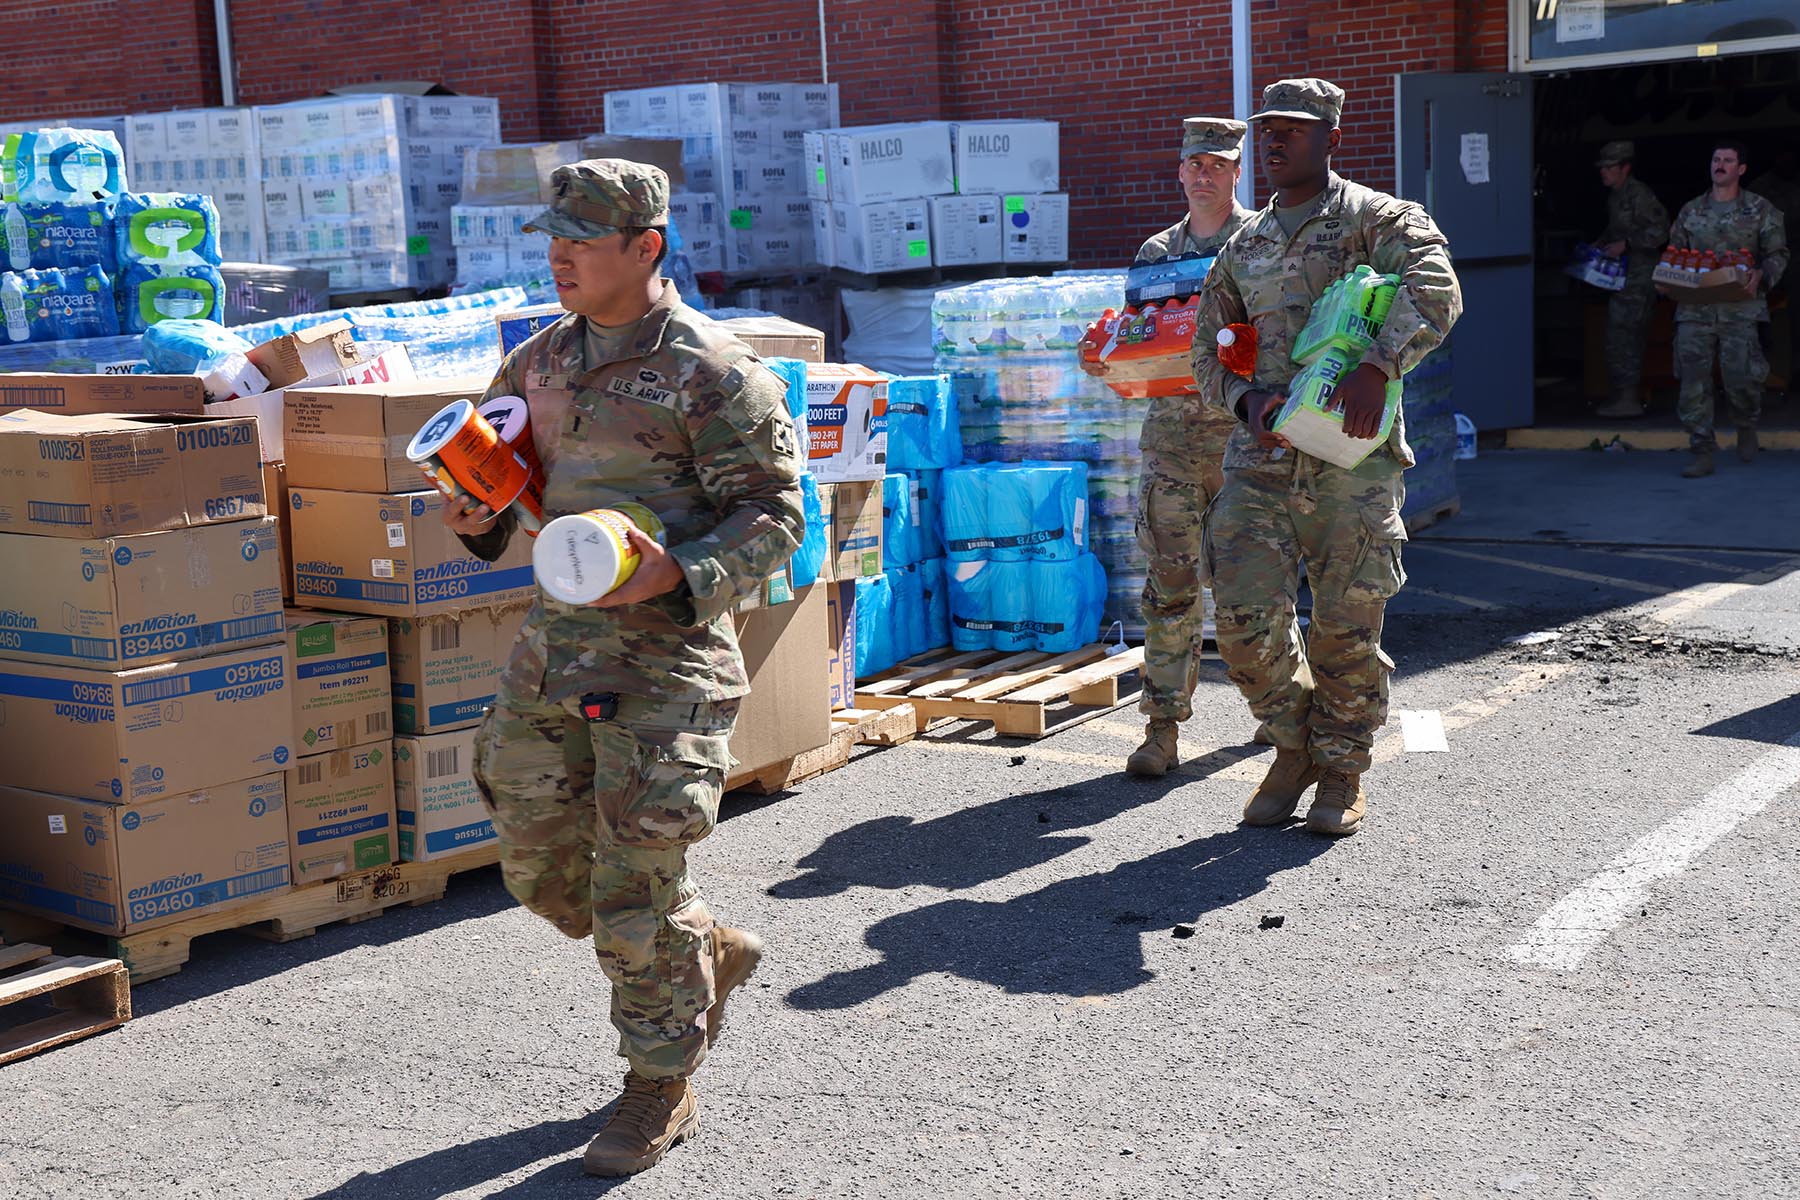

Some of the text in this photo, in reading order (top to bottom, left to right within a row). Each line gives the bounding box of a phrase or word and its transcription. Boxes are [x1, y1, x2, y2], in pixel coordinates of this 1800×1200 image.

[757, 92, 781, 101] SOFIA
[805, 92, 827, 101] SOFIA
[429, 106, 452, 116] SOFIA
[733, 130, 757, 139] SOFIA
[783, 130, 804, 139] SOFI
[860, 138, 903, 161] HALCO
[968, 134, 1010, 153] HALCO
[762, 168, 785, 177] SOFIA
[313, 189, 336, 199] SOFIA
[787, 203, 810, 213] SOFIA
[416, 220, 439, 230] SOFIA
[45, 226, 98, 240] niagara
[765, 240, 789, 249] SOFIA
[42, 294, 95, 308] niagara
[105, 365, 136, 374] 2YW
[538, 376, 550, 387] LE
[807, 383, 836, 392] ARATHON
[613, 379, 670, 404] U.S. ARMY
[824, 408, 842, 420] FEET
[870, 419, 876, 430] 6
[823, 430, 838, 440] 2-PLY
[820, 441, 838, 449] PAPER
[205, 495, 244, 518] 6667
[1016, 530, 1051, 546] 19378
[296, 560, 344, 577] enMotion
[414, 559, 492, 582] enMotion
[298, 577, 337, 595] 89460
[417, 578, 468, 601] 89460
[119, 611, 198, 636] enMotion
[124, 632, 187, 656] 89460
[224, 659, 282, 684] 89460
[312, 663, 336, 676] Jumbo
[351, 658, 371, 668] Tissue
[320, 675, 369, 690] Item #92211
[72, 683, 114, 705] 89460
[214, 678, 284, 703] enMotion
[55, 703, 116, 724] enMotion
[455, 702, 483, 716] Tissue
[317, 725, 334, 740] CT
[354, 757, 369, 769] CT
[438, 783, 450, 792] Per
[318, 803, 368, 821] Item #92211
[352, 818, 374, 830] Jumbo
[316, 826, 340, 837] Tissue
[454, 827, 483, 841] Tissue
[127, 871, 203, 900] enMotion
[132, 890, 194, 921] 89460
